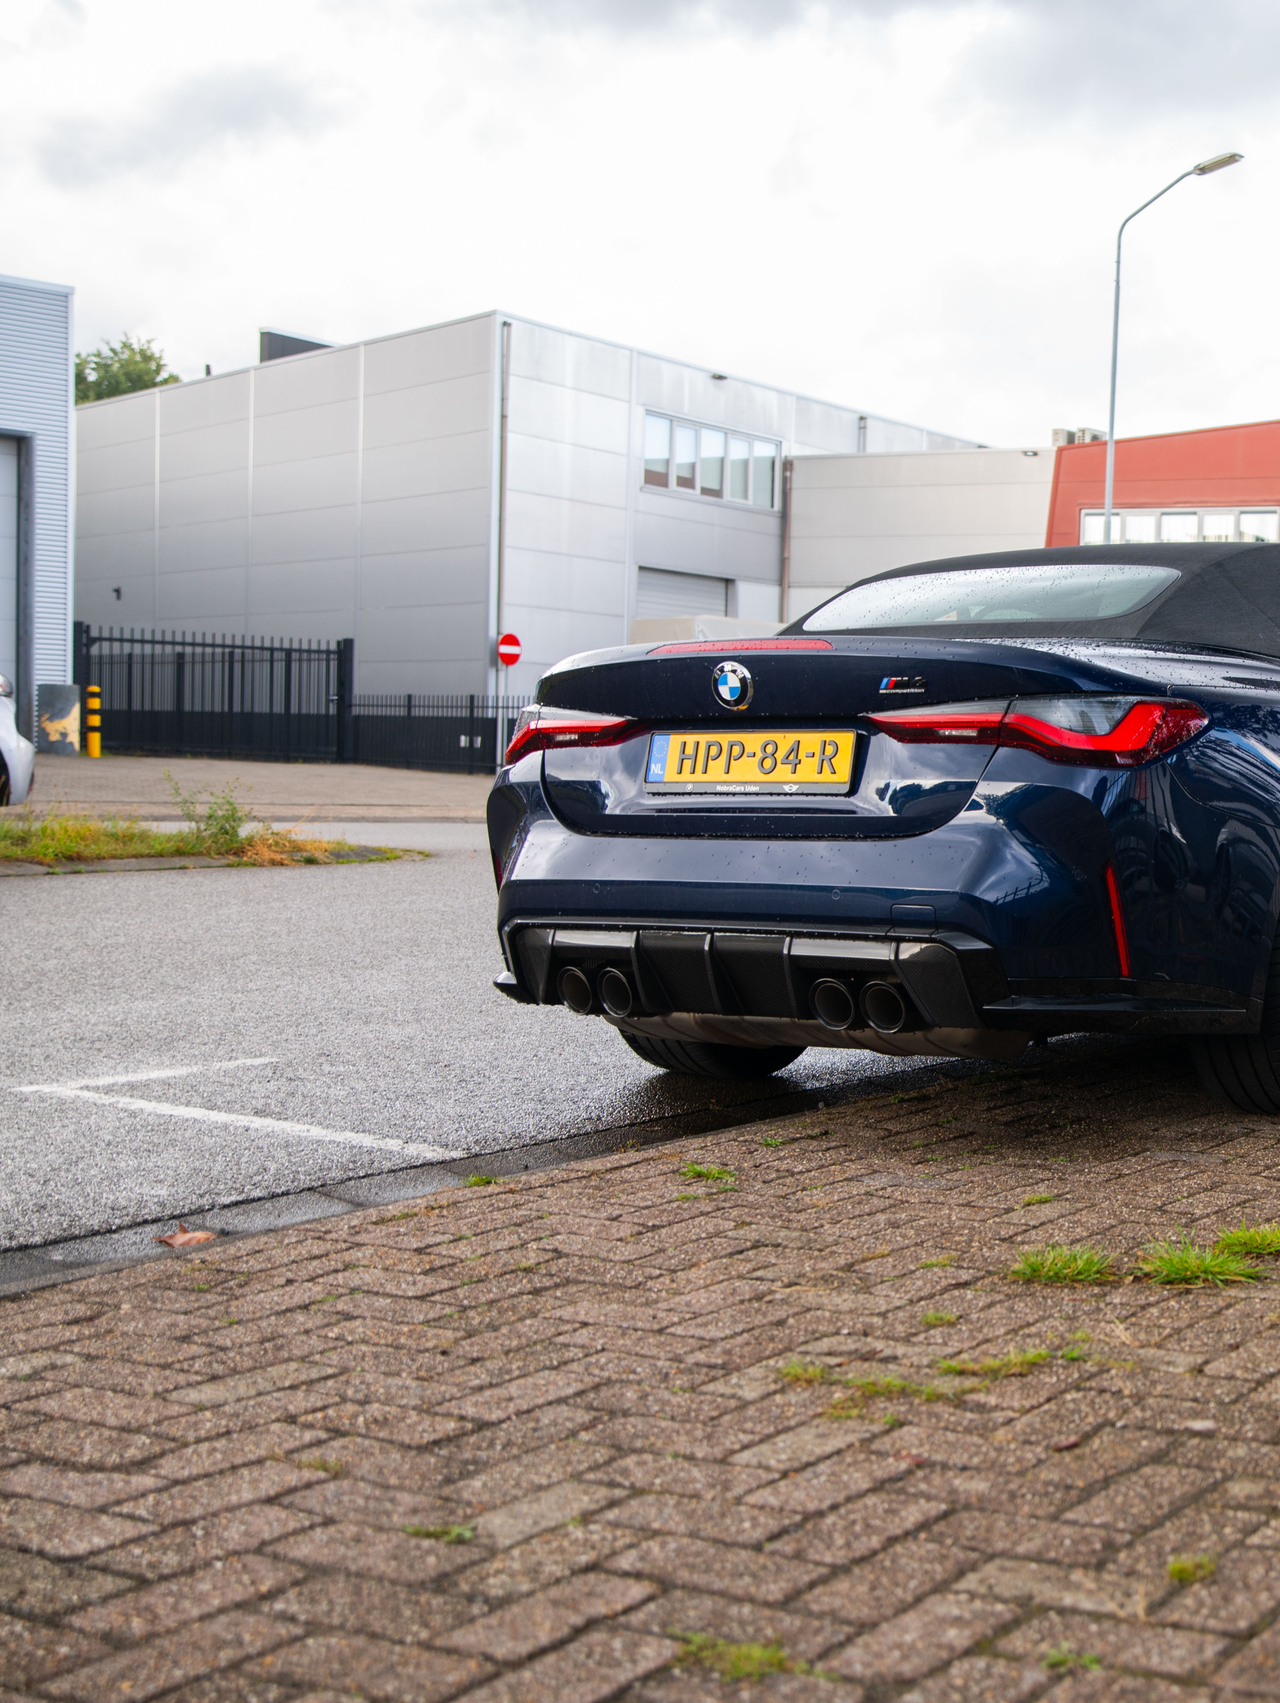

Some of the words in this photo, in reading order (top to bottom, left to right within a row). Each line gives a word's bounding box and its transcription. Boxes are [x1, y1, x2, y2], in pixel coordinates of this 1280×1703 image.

[714, 664, 745, 679] BMW
[676, 739, 839, 774] HPP-84-R
[650, 763, 664, 774] NL
